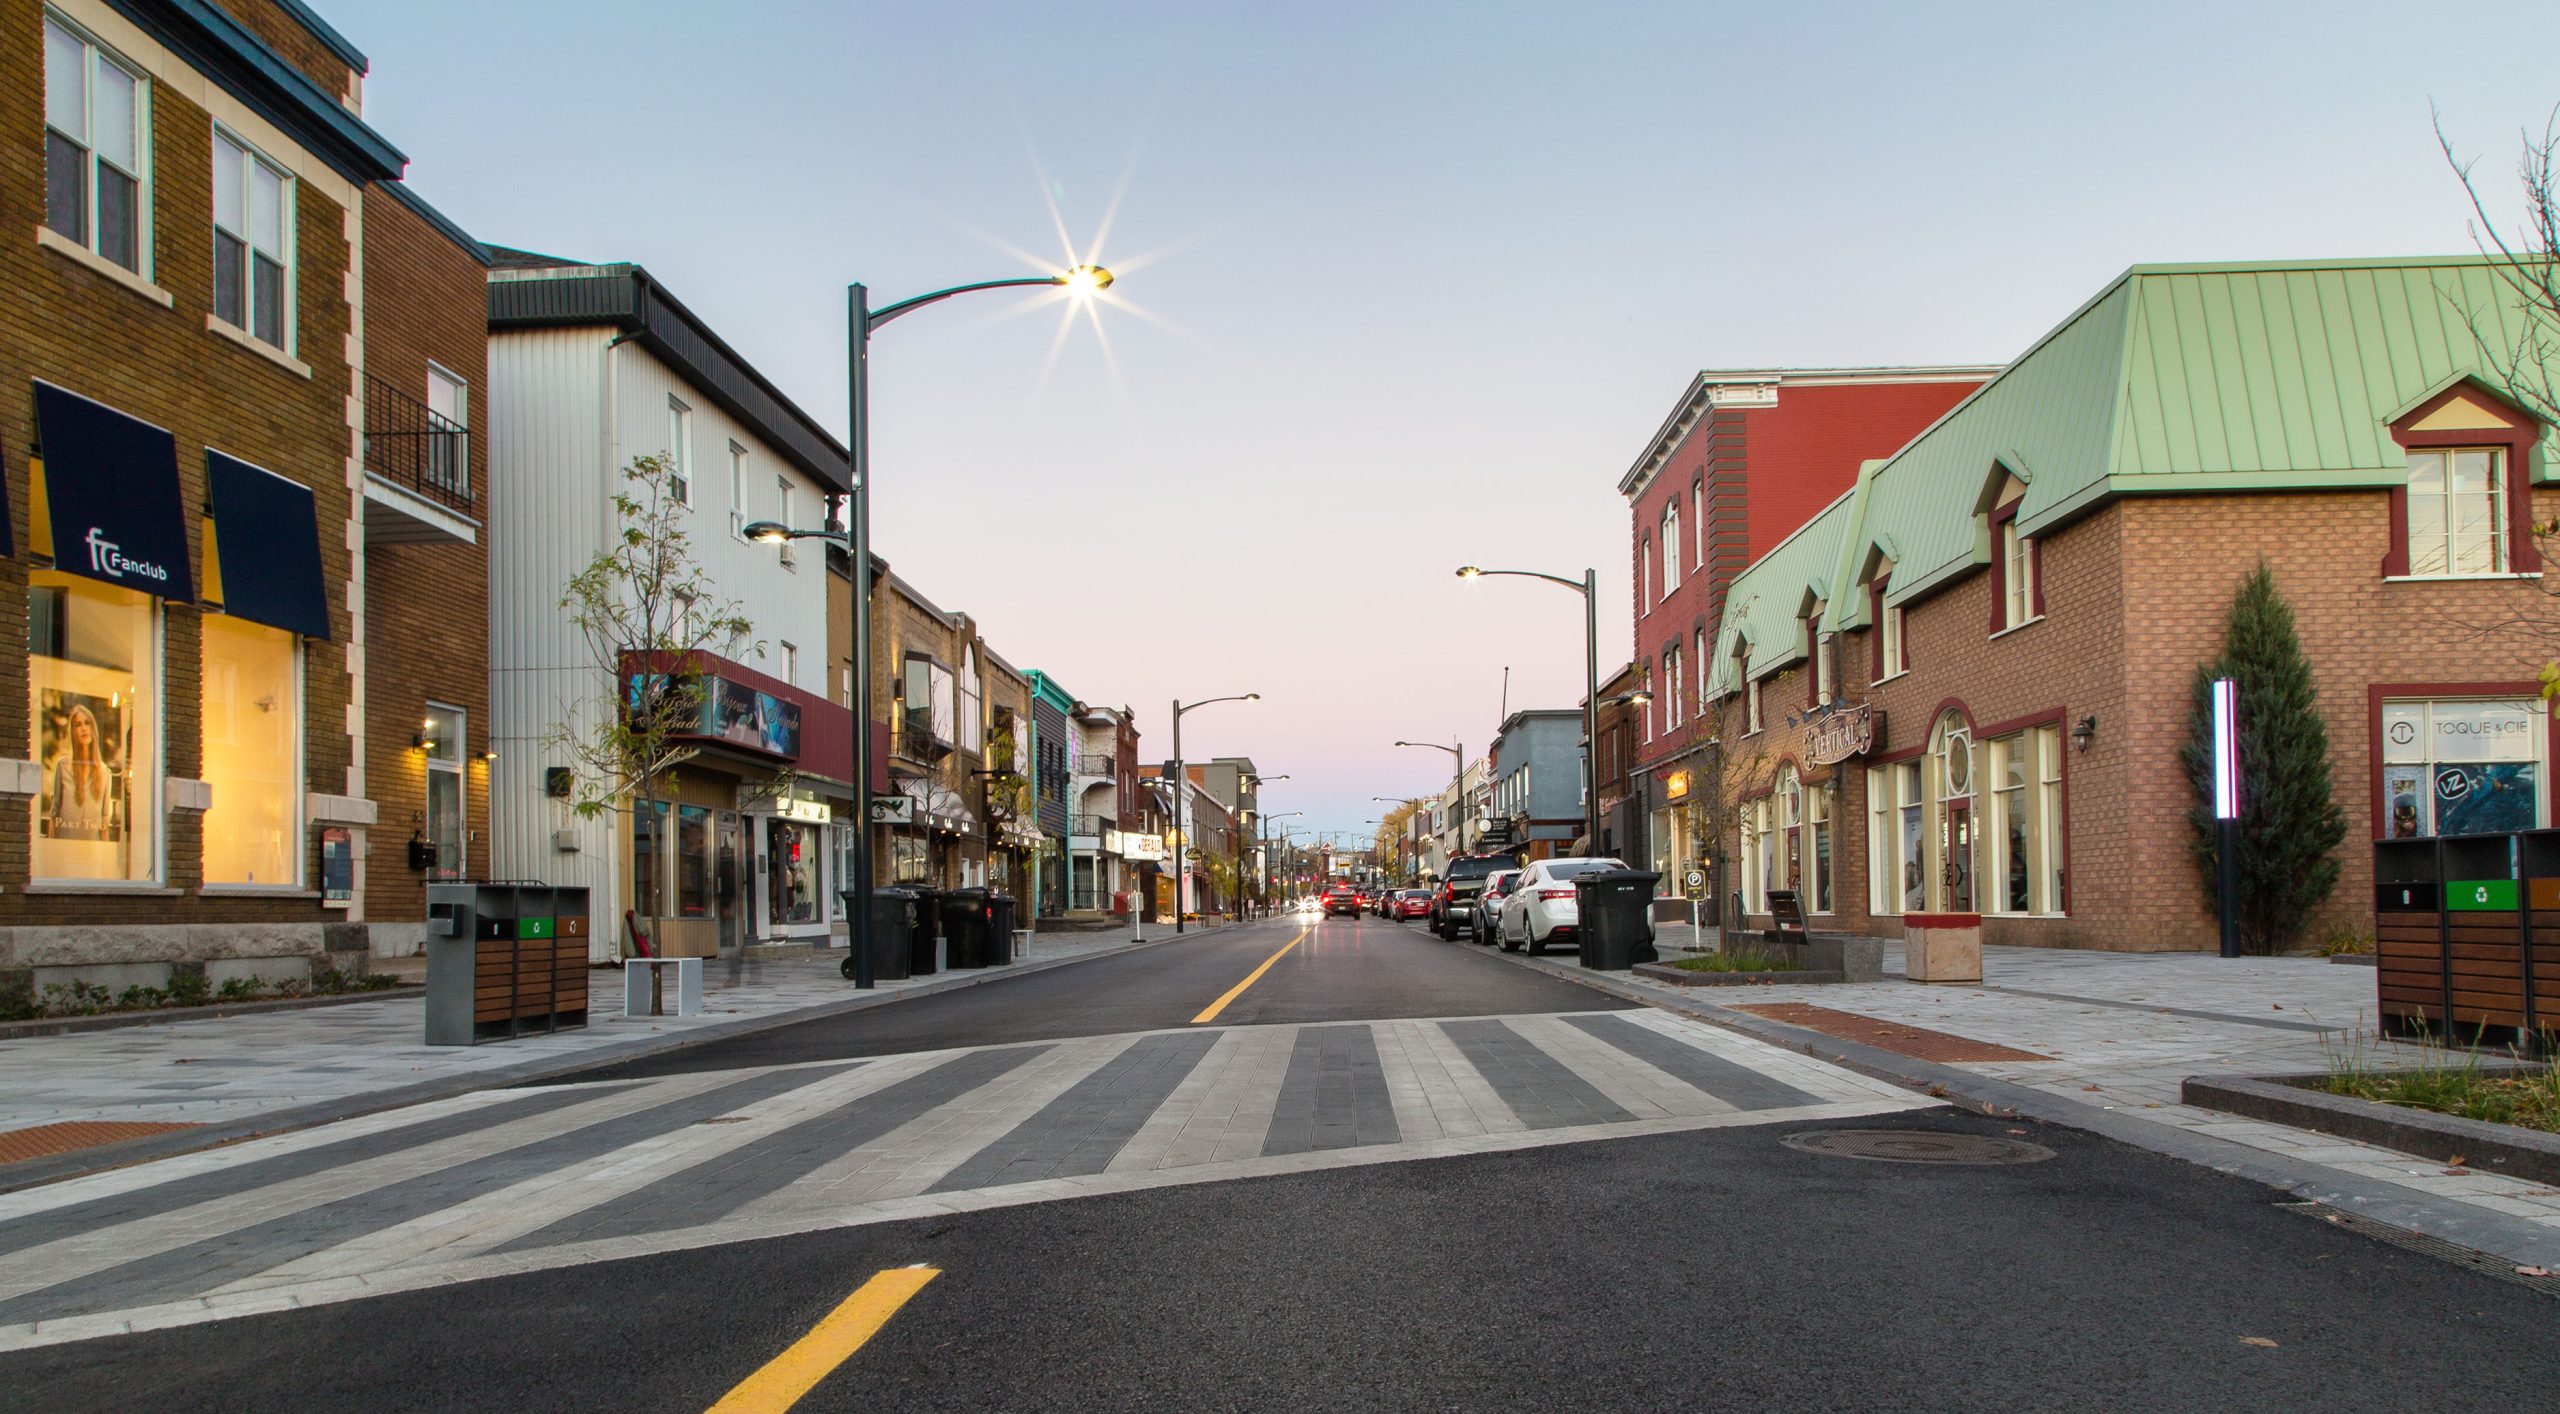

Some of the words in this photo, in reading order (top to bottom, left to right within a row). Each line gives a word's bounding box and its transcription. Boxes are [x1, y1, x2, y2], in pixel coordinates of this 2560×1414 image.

[111, 552, 167, 581] Fanclub
[1814, 724, 1857, 756] VERTICAL
[2436, 721, 2491, 735] TOQUE
[2494, 723, 2503, 732] &
[2504, 721, 2528, 734] CIE
